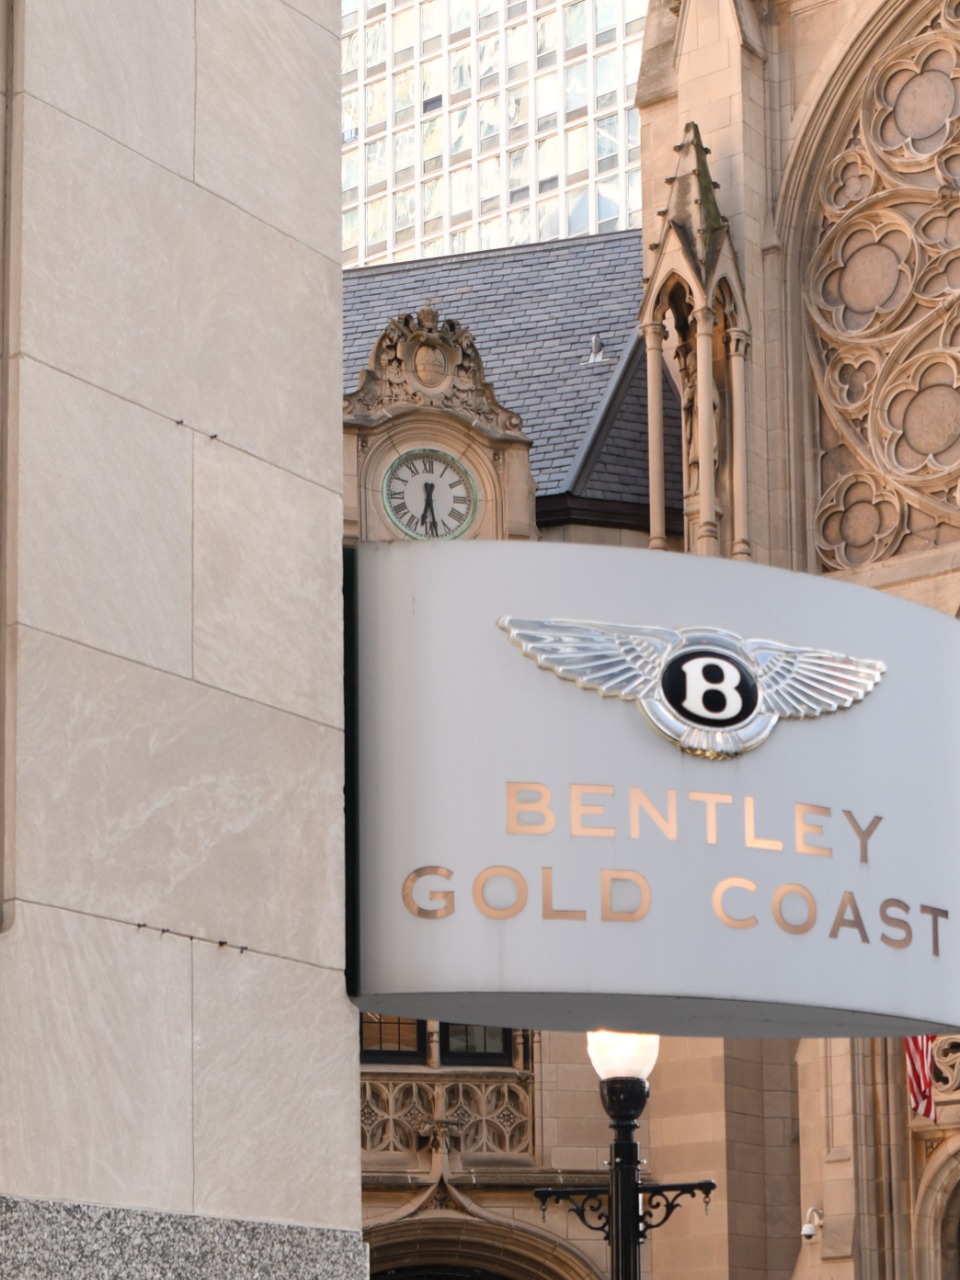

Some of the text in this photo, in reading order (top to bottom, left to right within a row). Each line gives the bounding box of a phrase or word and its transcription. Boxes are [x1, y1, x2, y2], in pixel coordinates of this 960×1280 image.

[681, 655, 744, 721] B
[505, 780, 884, 865] BENTLEY
[401, 864, 950, 958] GOLD COAST
